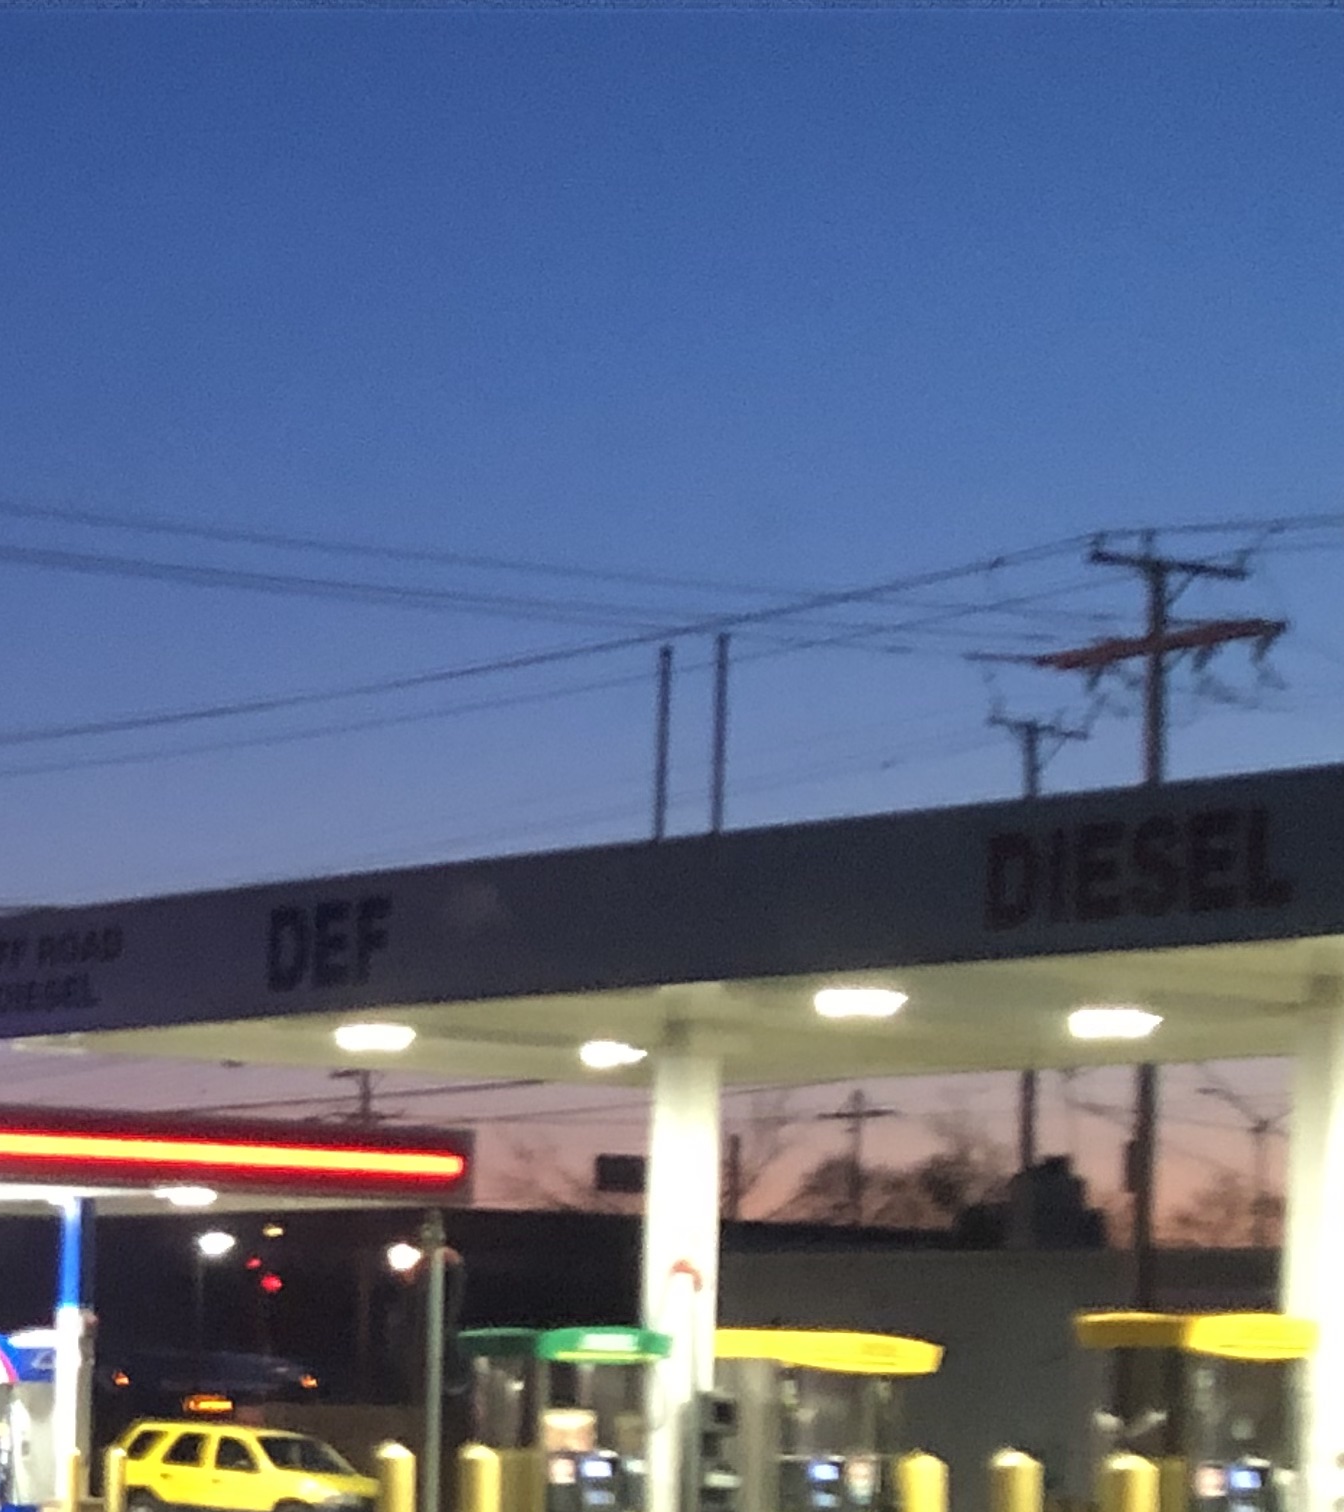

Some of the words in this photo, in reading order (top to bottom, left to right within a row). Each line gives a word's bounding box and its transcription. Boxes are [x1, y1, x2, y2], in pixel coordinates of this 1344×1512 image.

[984, 803, 1295, 932] DIESEL
[37, 926, 125, 967] ROAD
[266, 894, 392, 993] DEF
